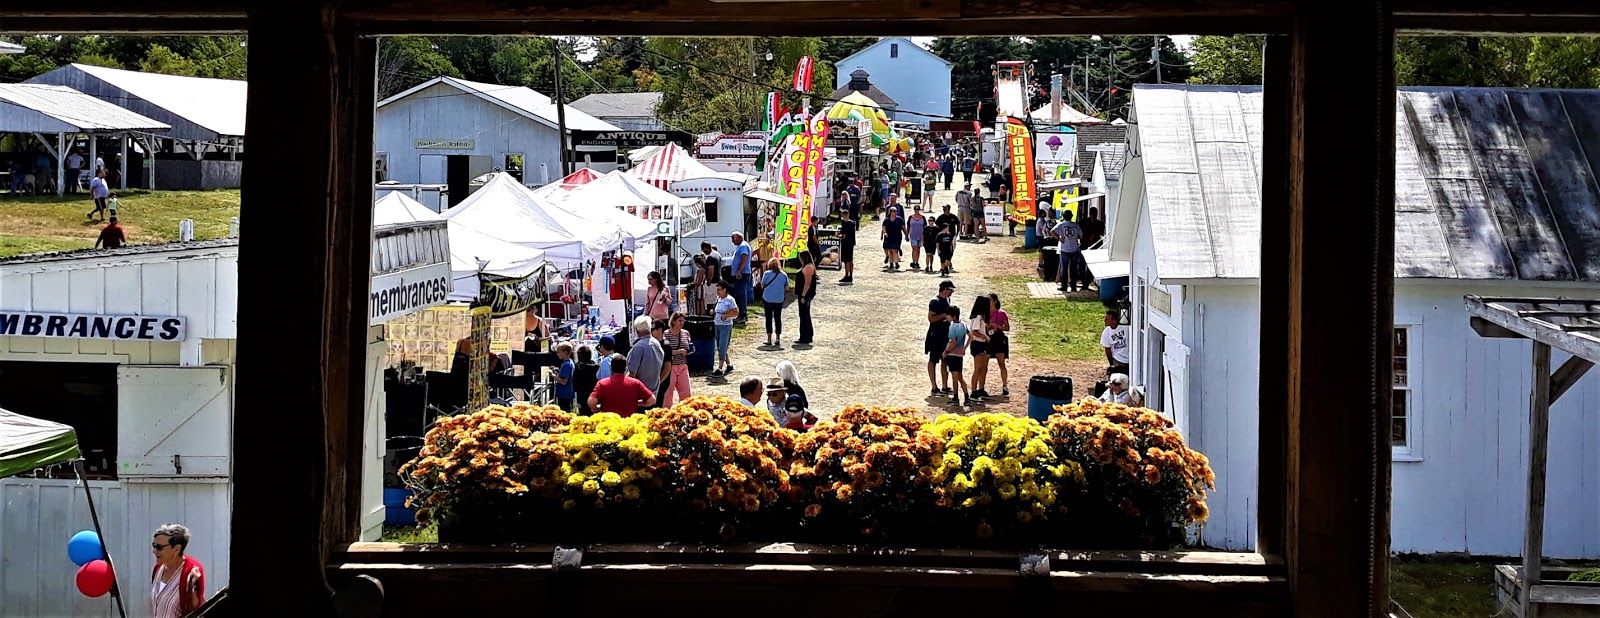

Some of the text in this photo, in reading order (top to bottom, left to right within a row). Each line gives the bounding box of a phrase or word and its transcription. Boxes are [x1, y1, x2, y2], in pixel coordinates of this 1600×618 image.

[596, 132, 667, 140] ANTIQUE
[742, 143, 762, 152] Shoppe
[797, 120, 825, 251] SMOOTHIES
[656, 221, 670, 234] G
[0, 314, 181, 340] MBRANCES
